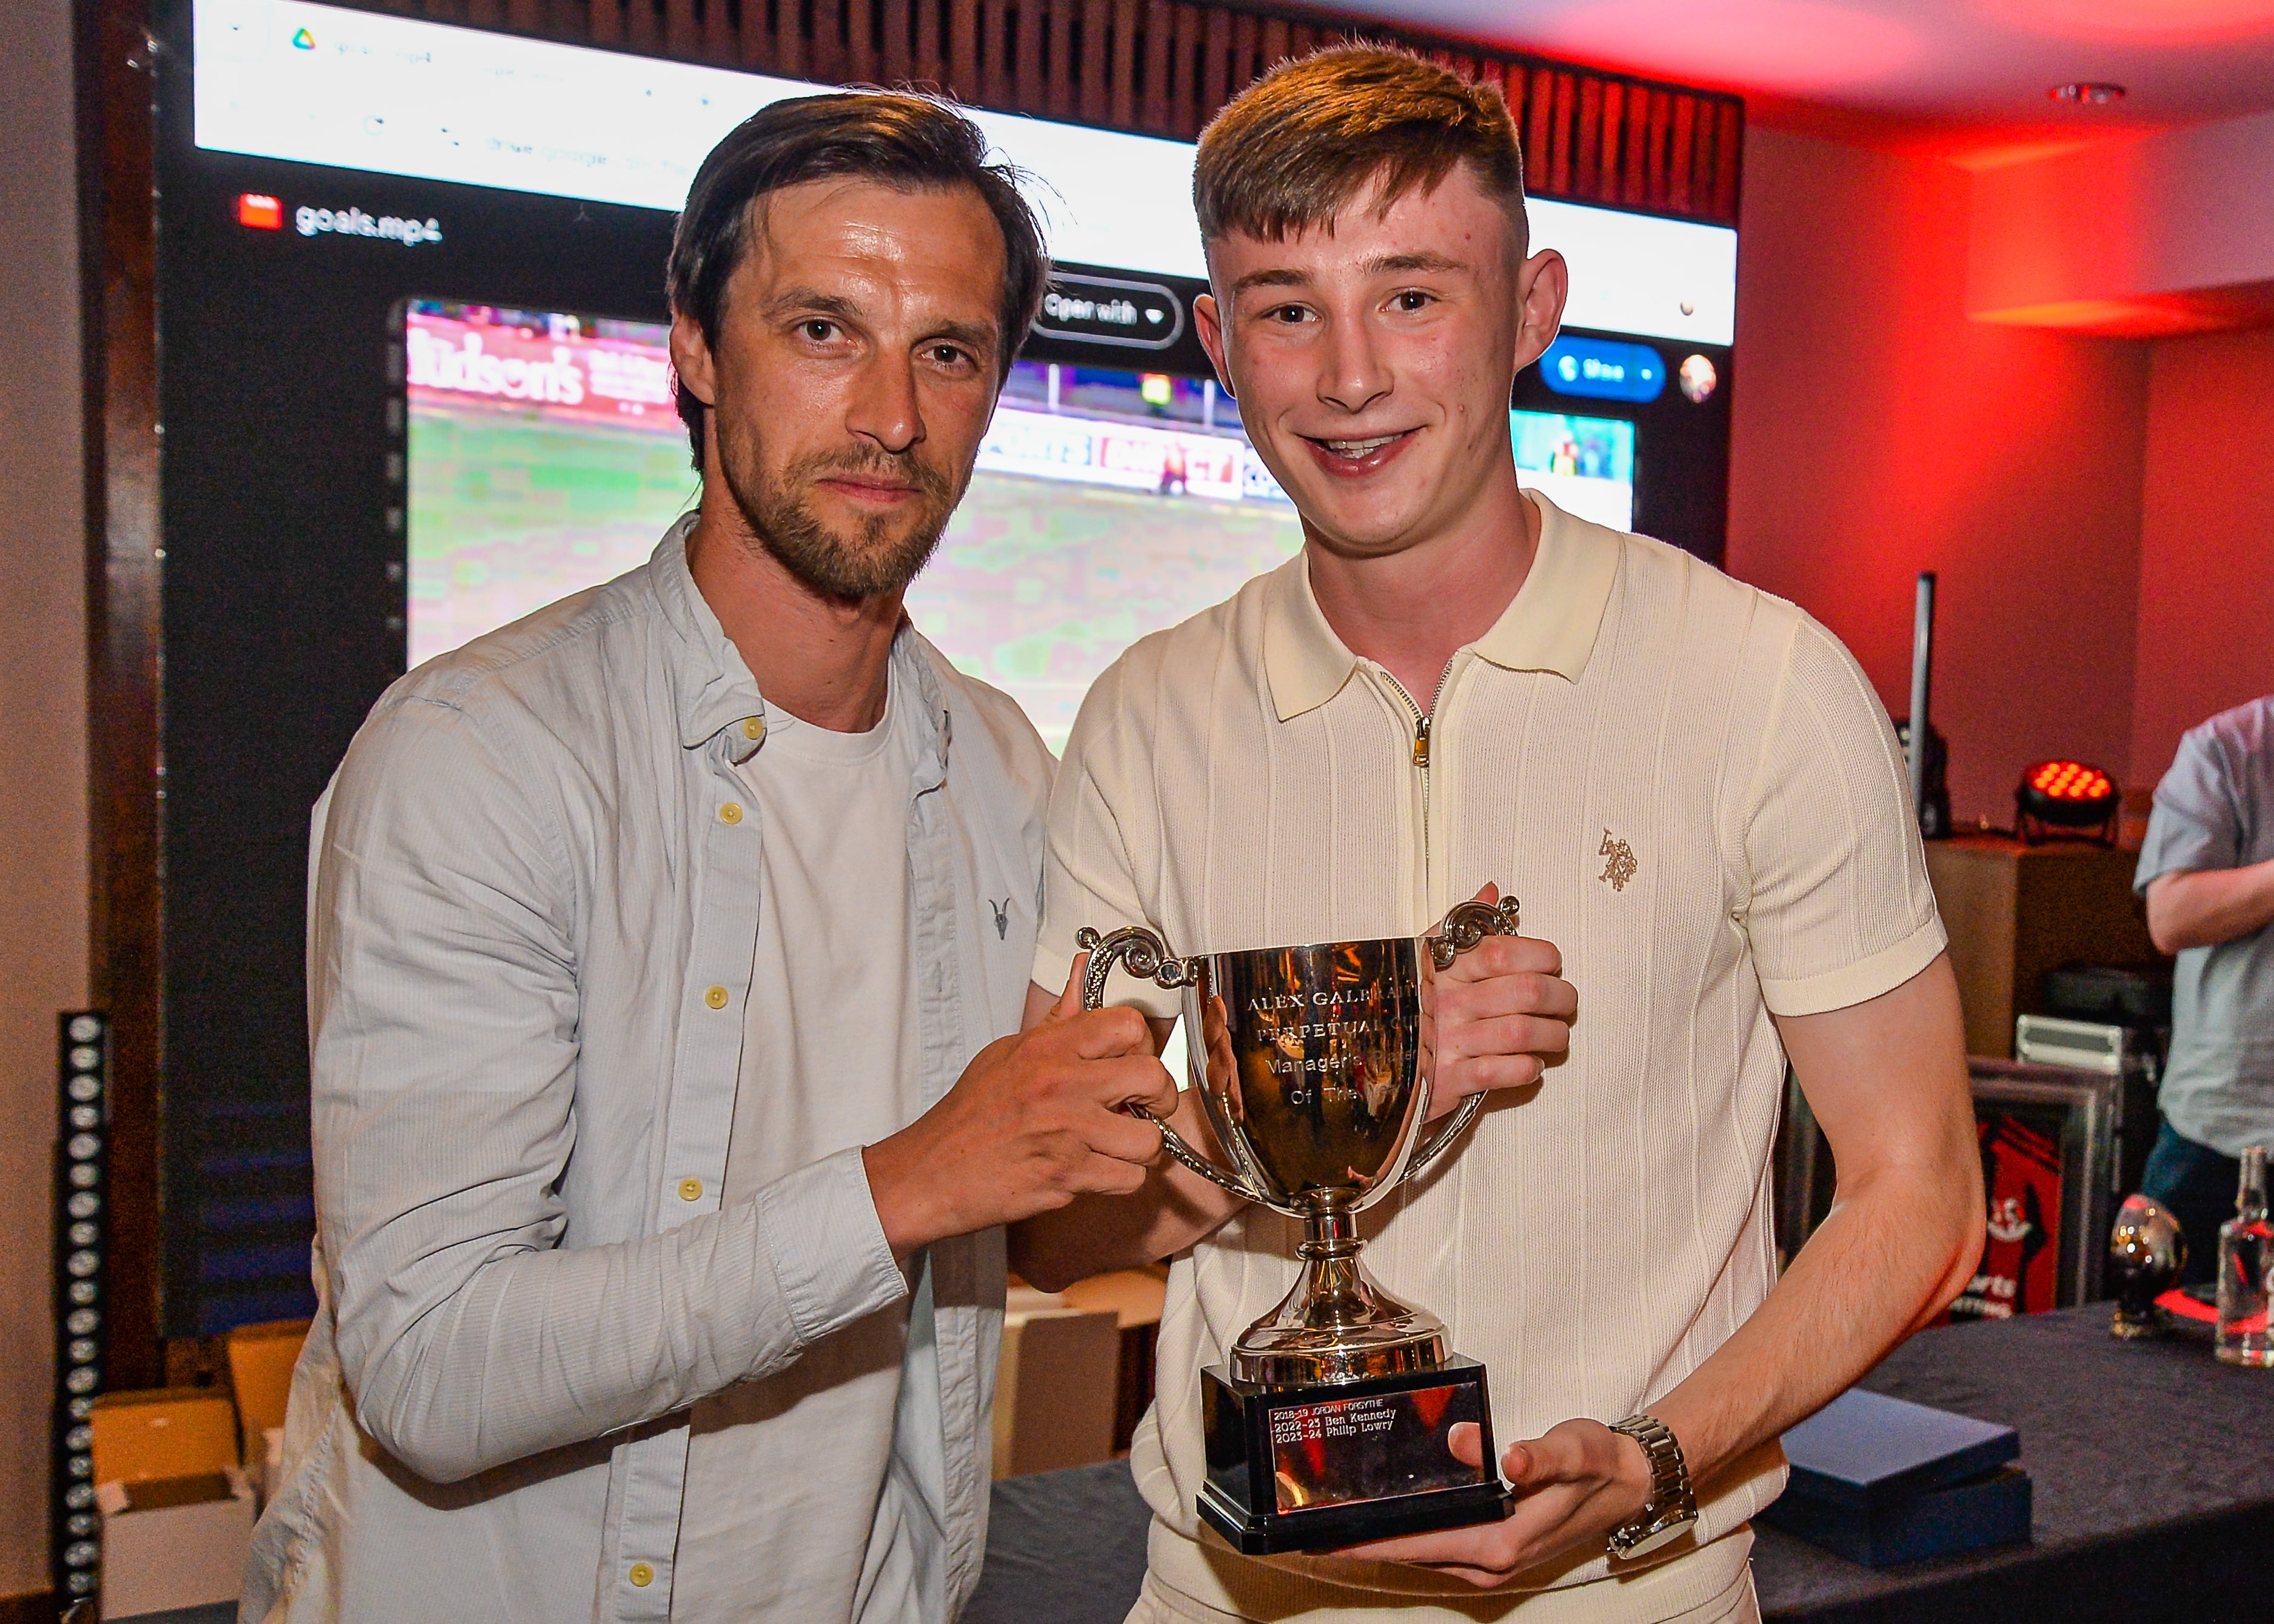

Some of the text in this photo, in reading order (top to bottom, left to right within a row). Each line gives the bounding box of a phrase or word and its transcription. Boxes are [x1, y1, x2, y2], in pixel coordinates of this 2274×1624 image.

[296, 206, 443, 247] goals.mp4
[1248, 994, 1304, 1011] ALEX
[1257, 1018, 1383, 1041] PERPETUAL
[1265, 1053, 1363, 1074] Manager's
[1291, 1087, 1357, 1104] Of The
[1274, 1399, 1383, 1420] 2018-19 JORDAN FORSYTHE
[1274, 1409, 1396, 1433] 2022-23 Ben Kennedy
[1276, 1420, 1393, 1444] 2023-24 Philip Lowry
